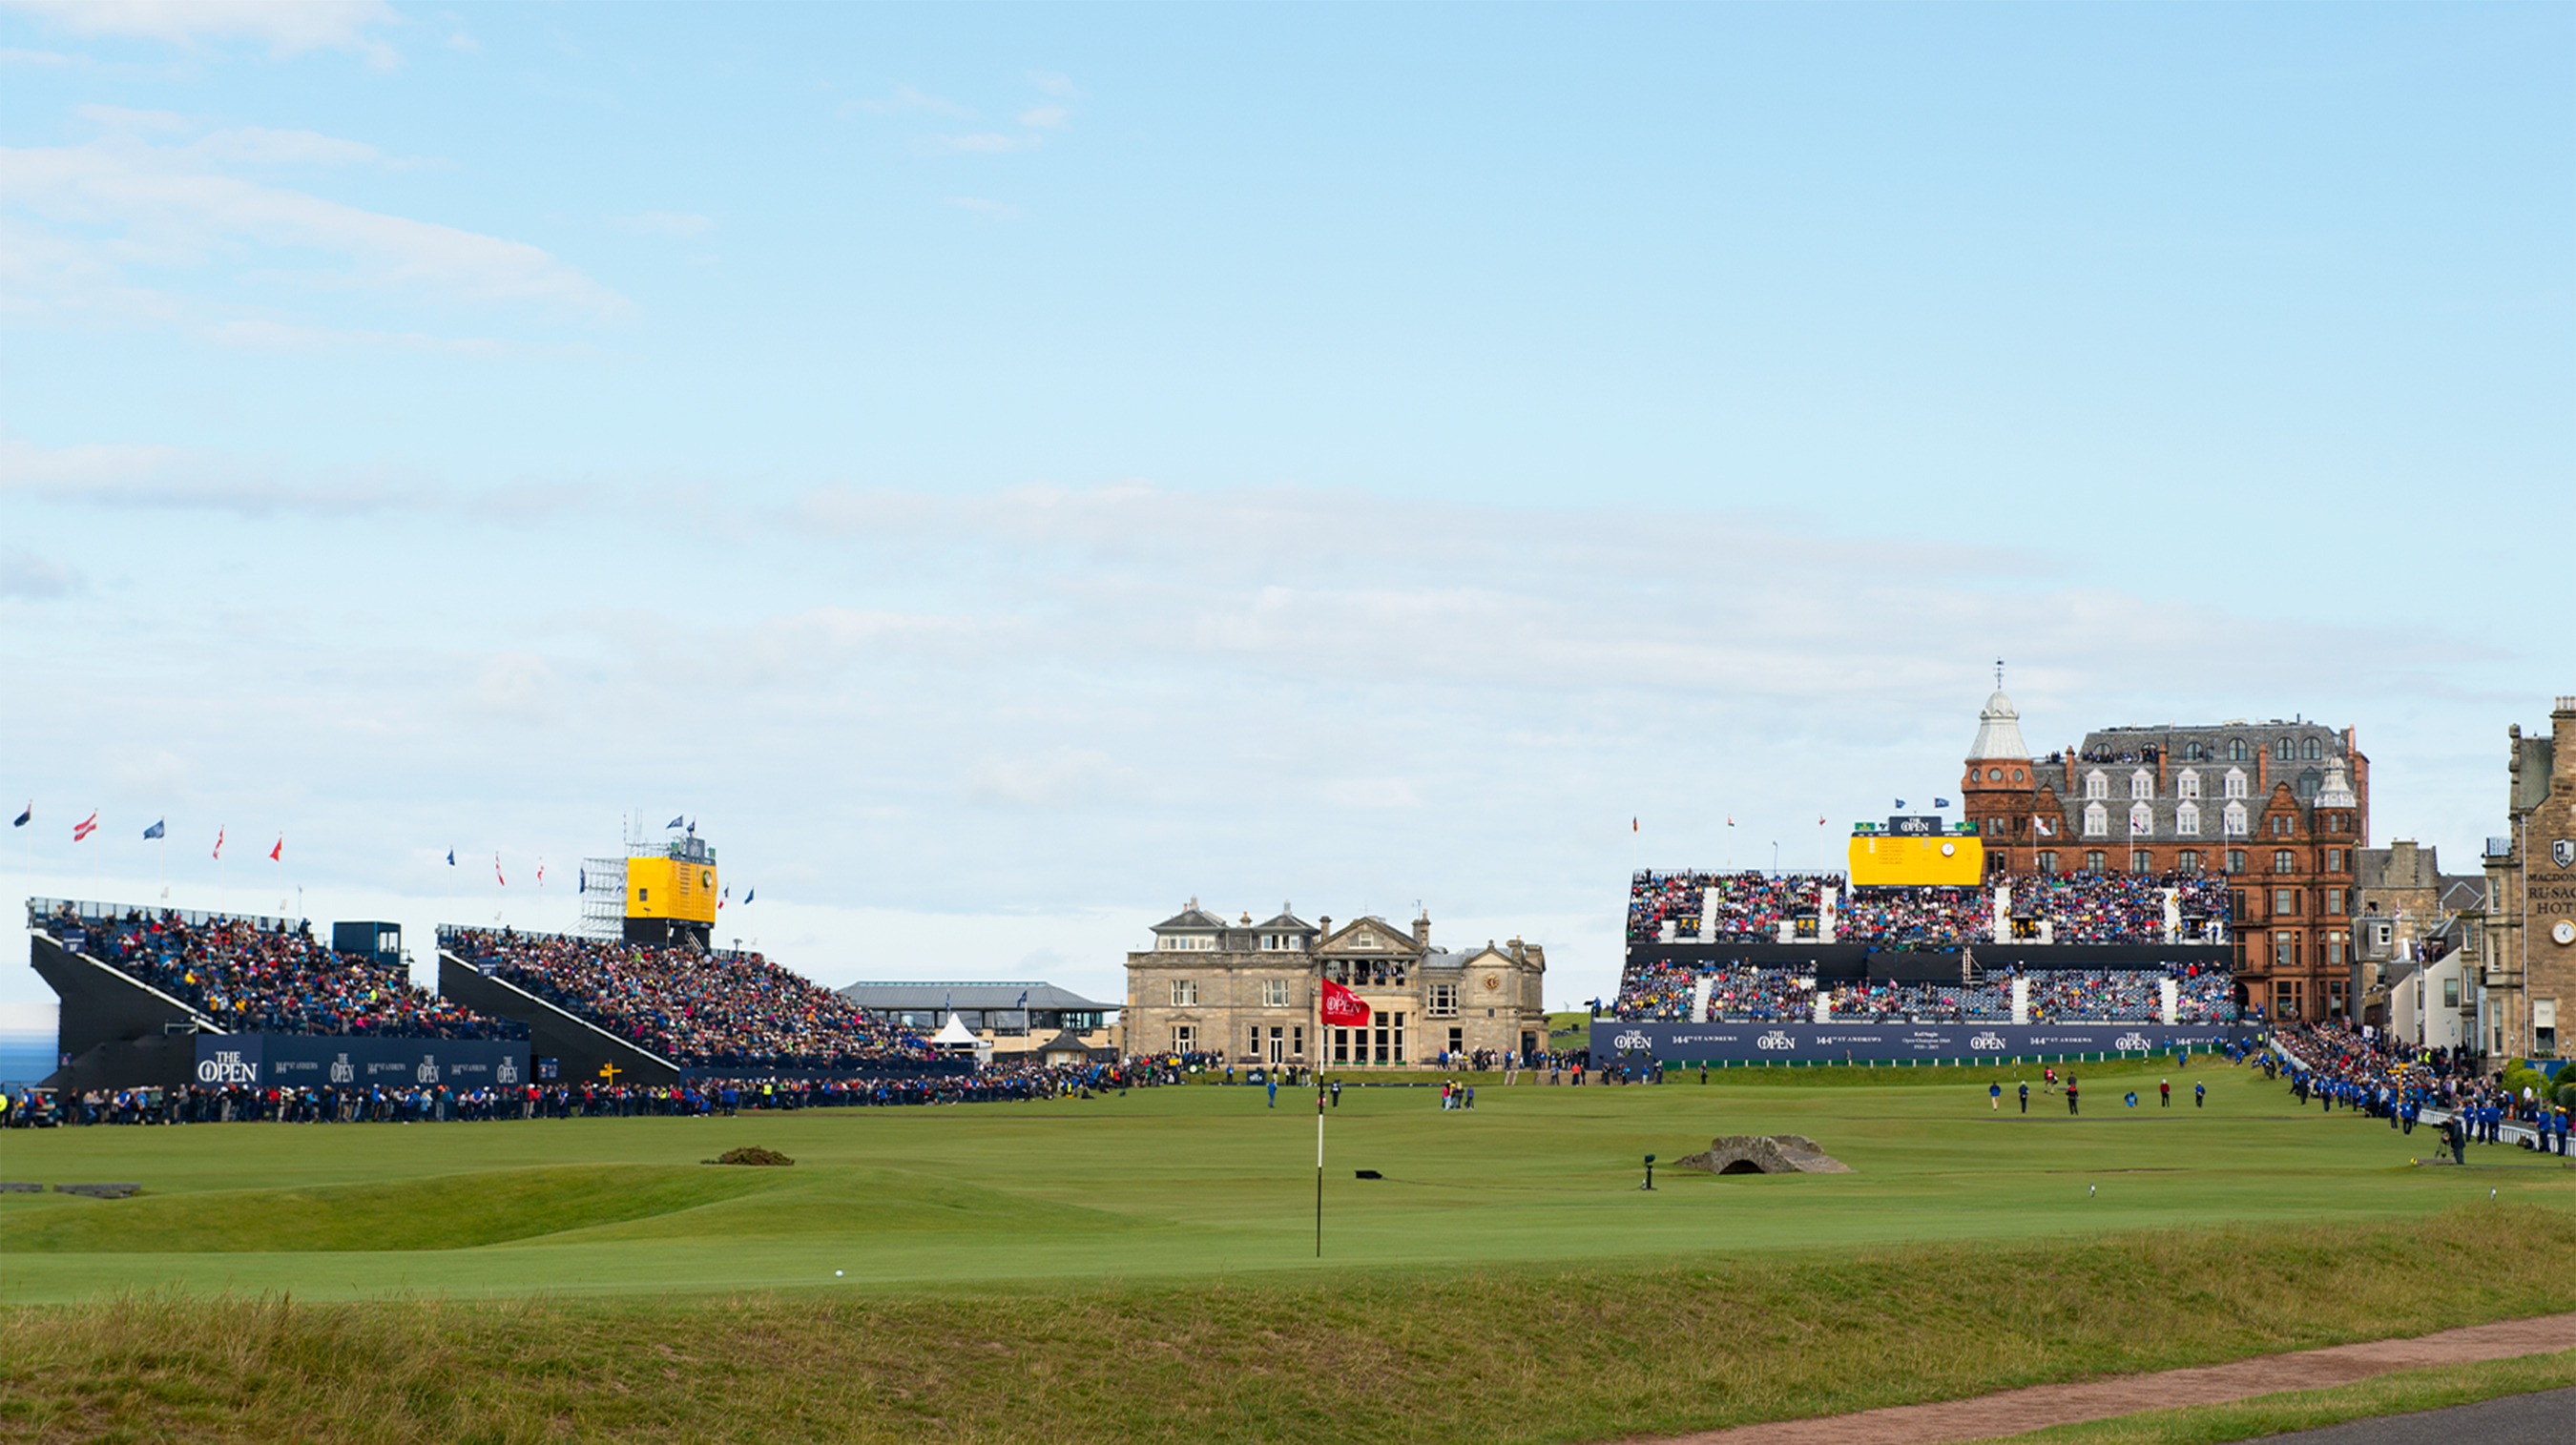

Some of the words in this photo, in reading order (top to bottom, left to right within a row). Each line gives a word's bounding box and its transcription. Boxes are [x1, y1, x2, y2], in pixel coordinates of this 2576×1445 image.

[1901, 821, 1929, 832] OPEN
[2537, 902, 2576, 915] HOT
[1326, 996, 1361, 1013] OPEN
[1614, 1035, 1652, 1049] OPEN
[1756, 1035, 1796, 1049] OPEN
[1970, 1036, 2005, 1050] OPEN
[2115, 1037, 2151, 1050] OPEN
[216, 1050, 240, 1063] THE
[197, 1060, 258, 1083] OPEN
[330, 1062, 355, 1083] OPEN
[417, 1063, 439, 1084] OPEN
[497, 1063, 518, 1084] OPEN
